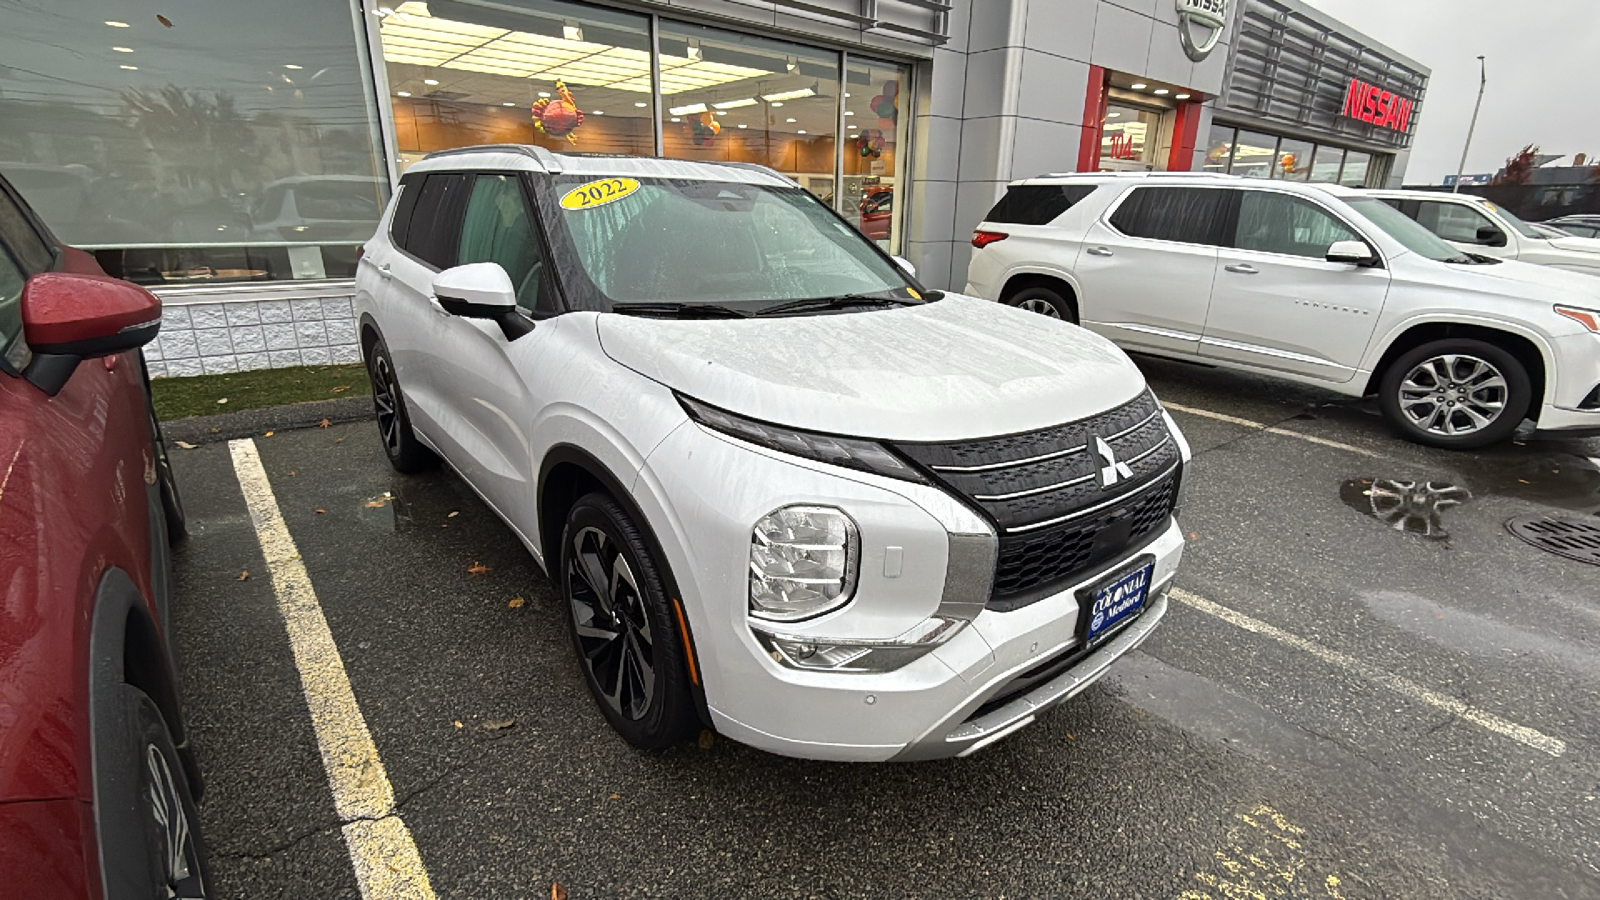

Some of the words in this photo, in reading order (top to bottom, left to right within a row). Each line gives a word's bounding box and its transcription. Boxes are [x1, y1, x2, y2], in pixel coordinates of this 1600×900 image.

[1343, 78, 1412, 132] NISSAN
[1109, 132, 1133, 160] 104
[575, 179, 627, 206] 2022
[1092, 572, 1147, 616] COLONIAL
[1106, 590, 1141, 621] Medford
